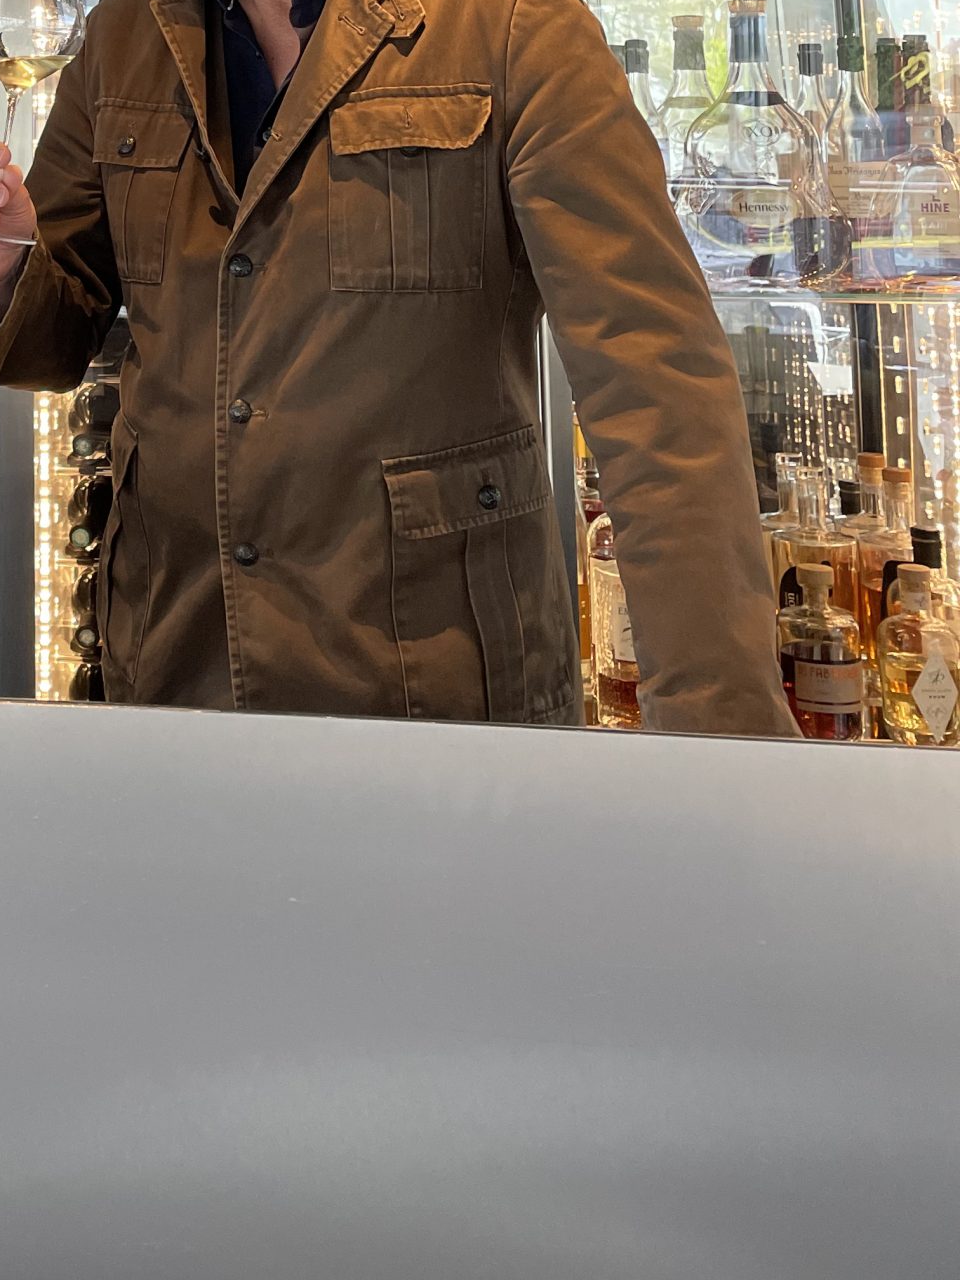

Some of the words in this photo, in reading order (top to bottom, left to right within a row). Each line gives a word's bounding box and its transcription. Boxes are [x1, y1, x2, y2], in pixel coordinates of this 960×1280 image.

[747, 125, 773, 138] XO
[739, 201, 789, 214] Hennessy
[921, 202, 950, 213] HINE
